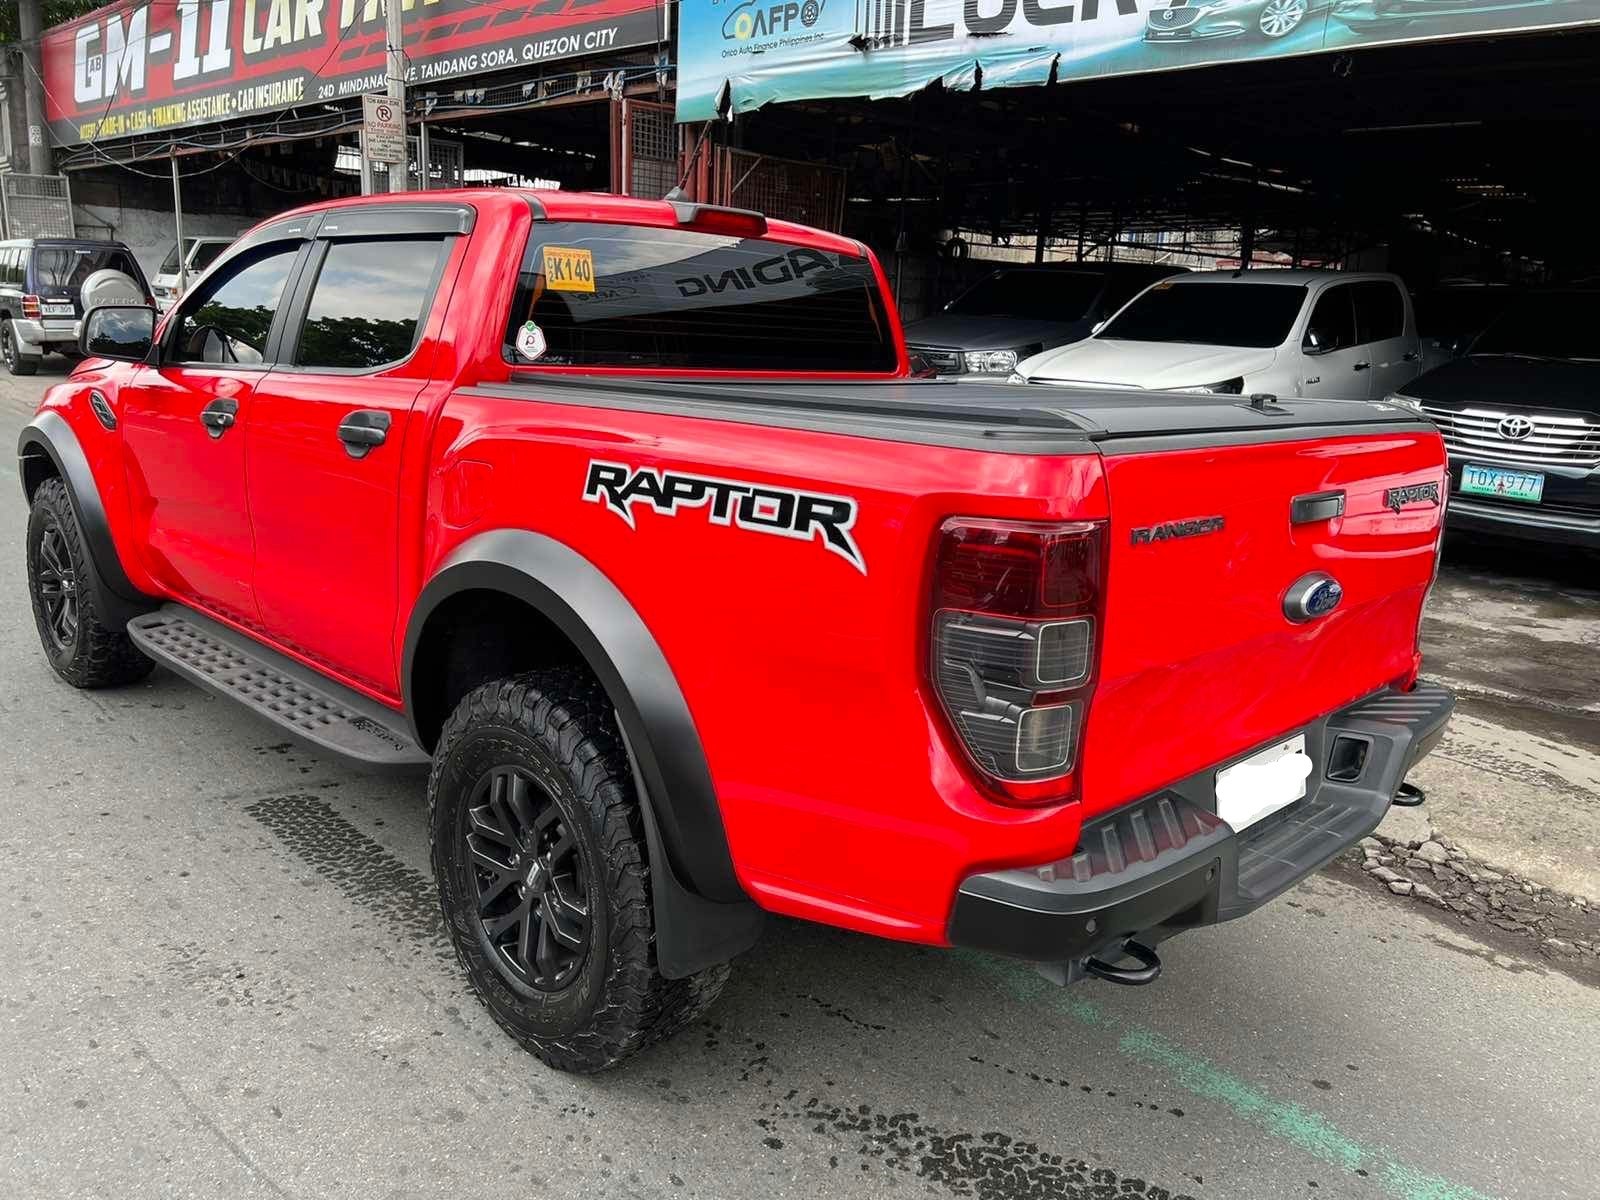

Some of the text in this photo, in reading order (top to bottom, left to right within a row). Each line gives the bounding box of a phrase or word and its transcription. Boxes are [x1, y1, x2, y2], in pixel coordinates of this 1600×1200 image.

[74, 0, 231, 103] GM-11
[753, 40, 778, 51] Finance
[318, 83, 334, 99] 24D
[421, 54, 478, 79] TANDANG
[480, 47, 518, 69] SORA,
[522, 34, 580, 60] QUEZON
[584, 27, 618, 49] CITY
[152, 101, 186, 127] FINANCING
[187, 92, 231, 121] ASSISTANCE
[238, 87, 254, 112] CAR
[255, 76, 304, 109] INSURANCE
[553, 257, 591, 282] K140
[1383, 481, 1440, 515] RAPTOR
[1506, 475, 1537, 492] 977
[581, 458, 868, 577] RAPTOR
[1130, 516, 1225, 545] RANGER
